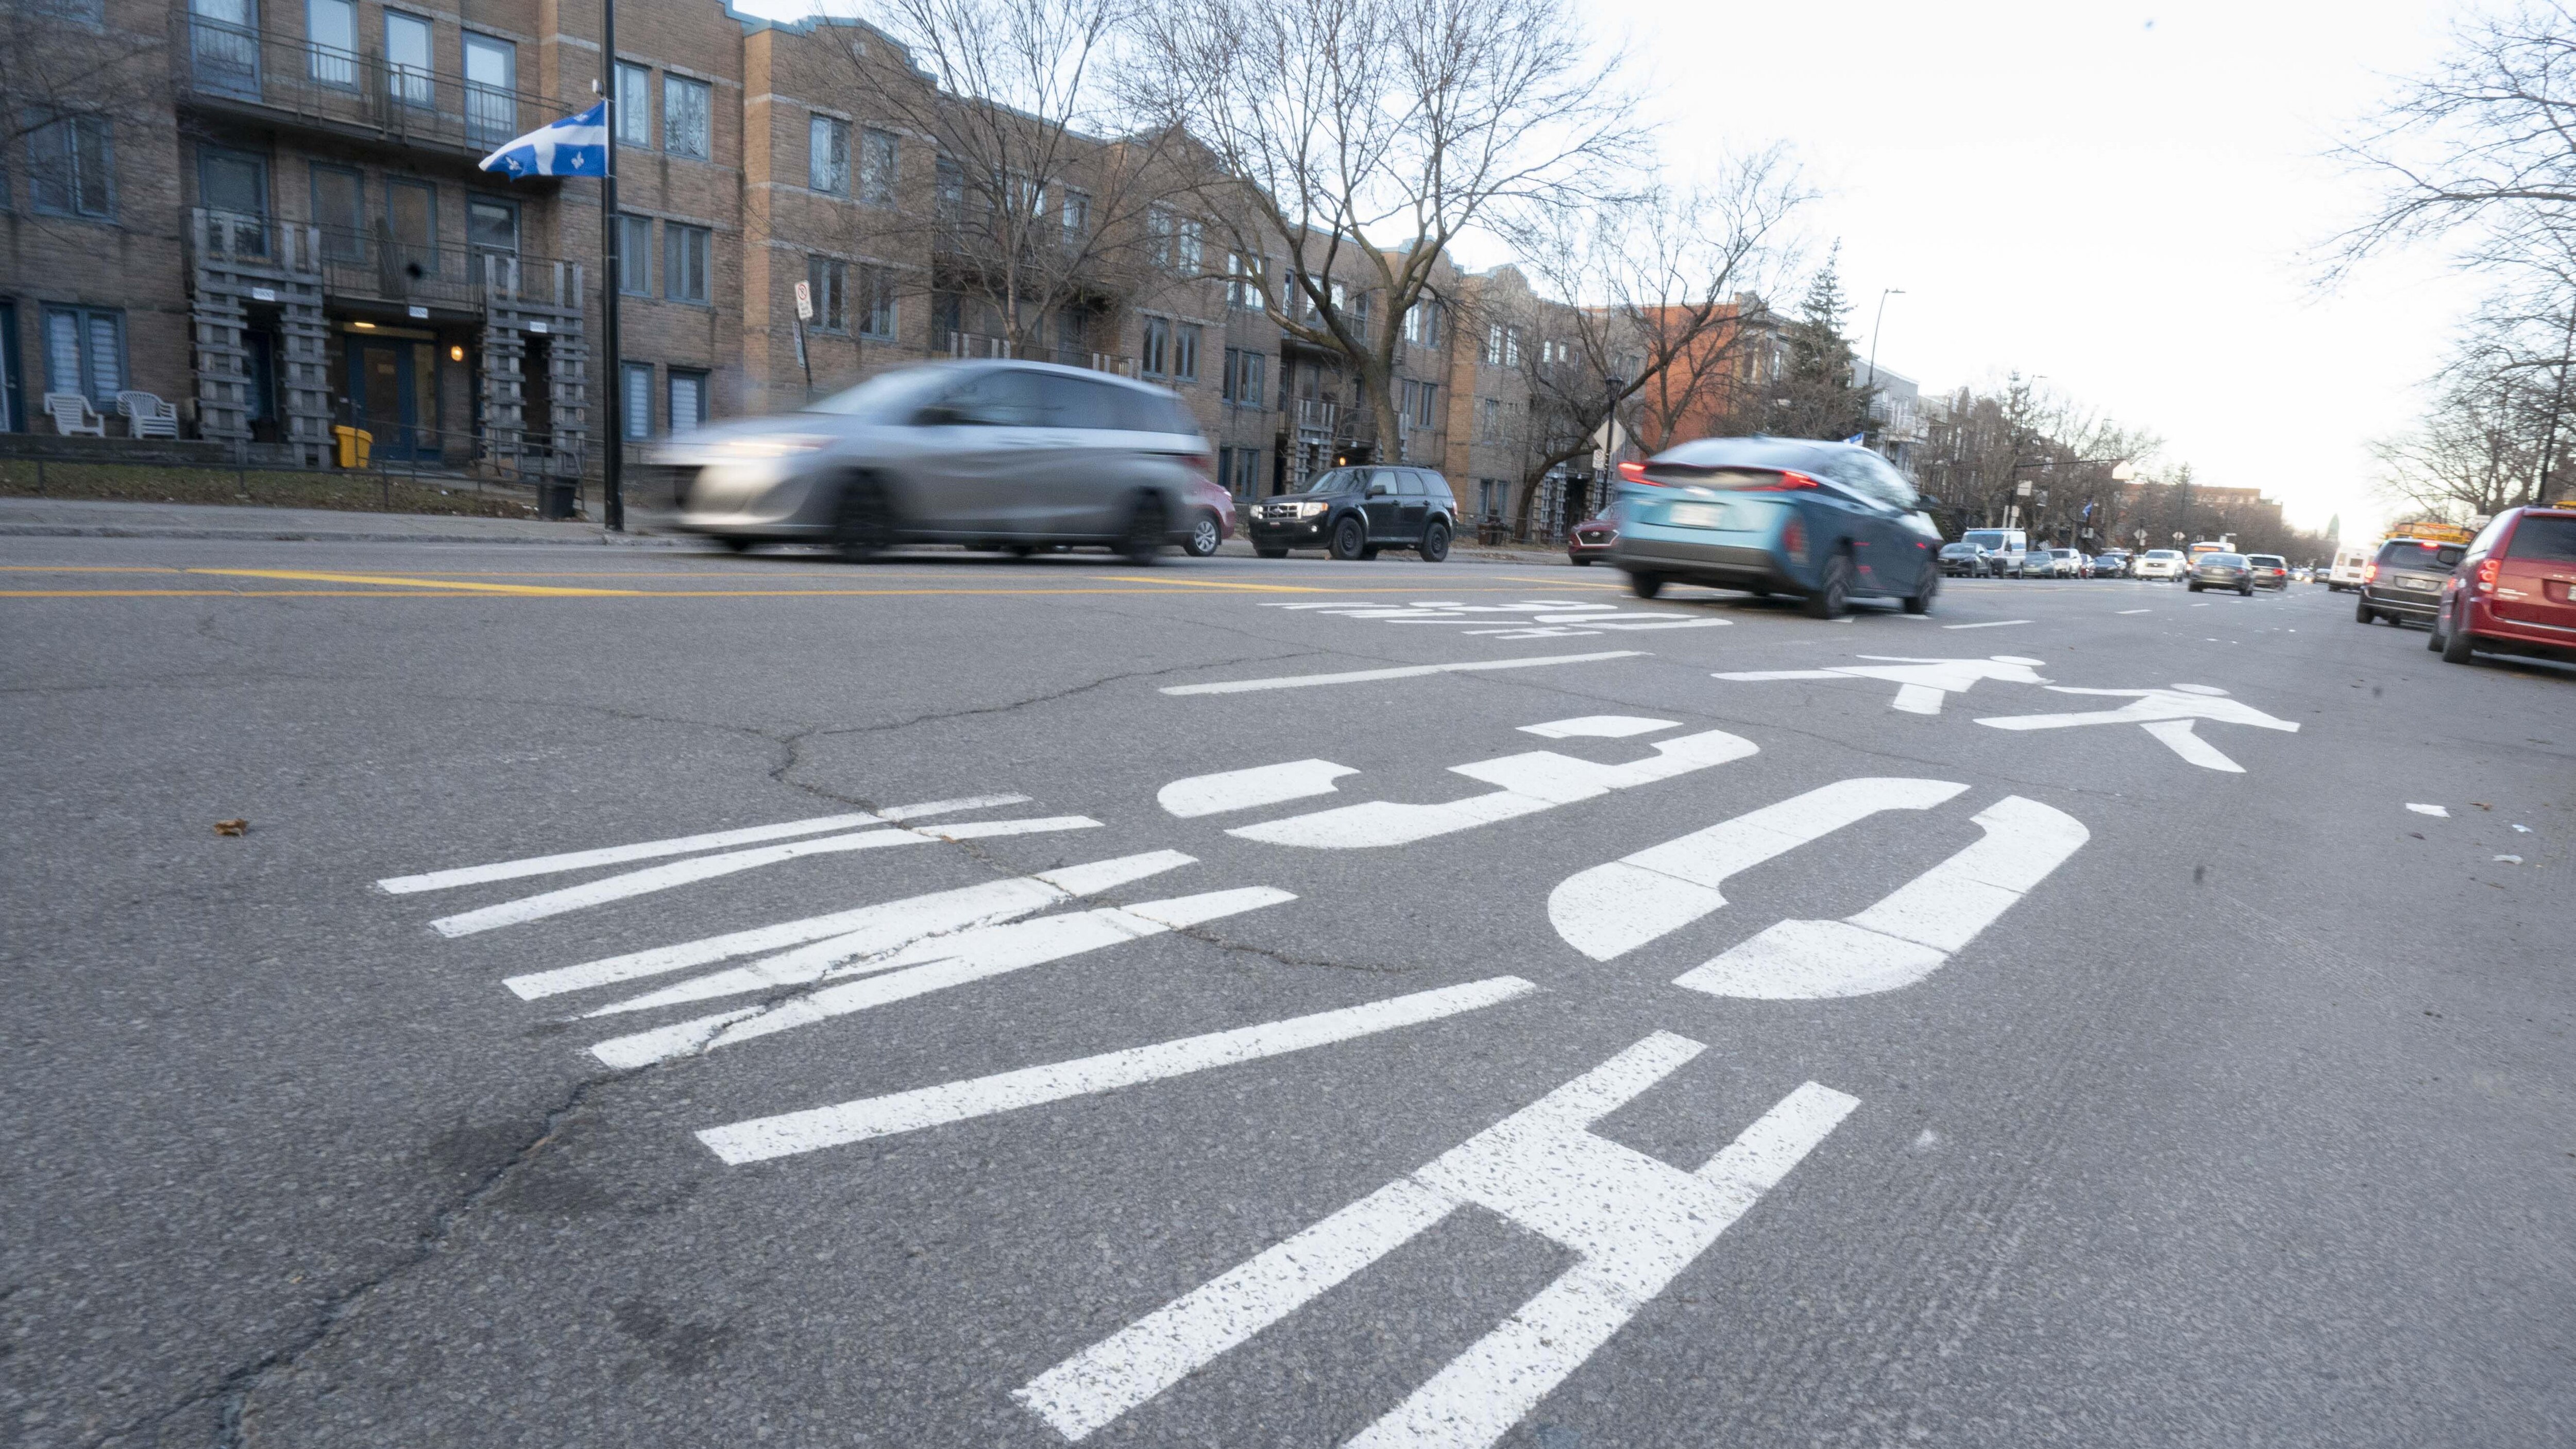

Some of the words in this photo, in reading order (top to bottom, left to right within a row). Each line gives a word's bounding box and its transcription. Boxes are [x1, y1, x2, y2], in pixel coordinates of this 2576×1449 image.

[1409, 600, 1733, 629] 30
[1158, 715, 2089, 1000] 30
[377, 793, 1861, 1449] KM/H
